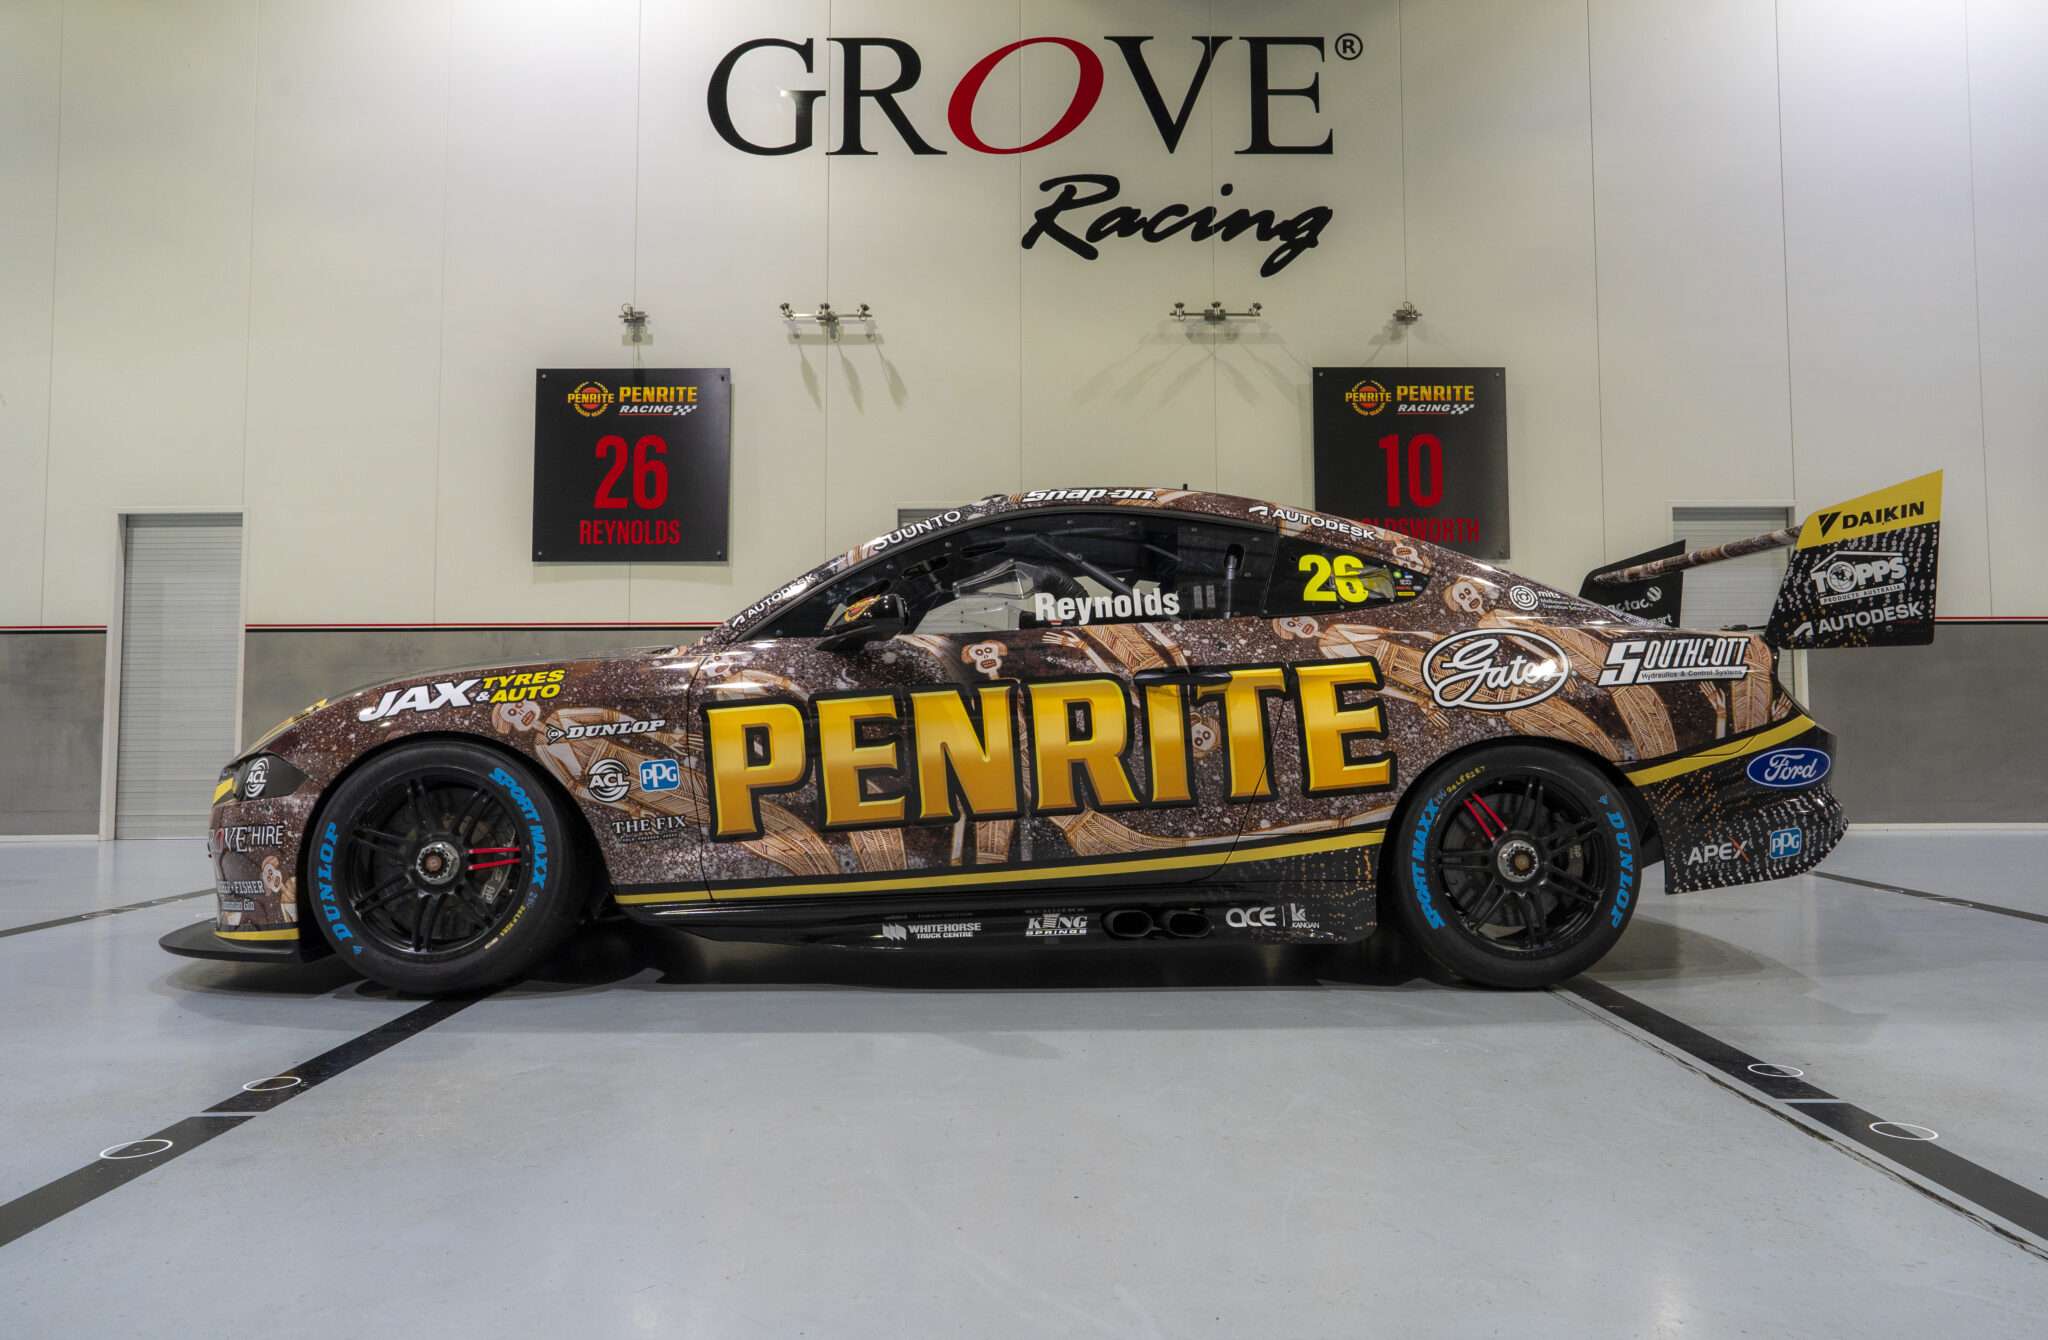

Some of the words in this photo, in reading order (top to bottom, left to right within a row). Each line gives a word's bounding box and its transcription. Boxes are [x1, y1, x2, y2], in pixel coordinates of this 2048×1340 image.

[707, 36, 1333, 156] GROVE
[1021, 173, 1333, 278] Racing
[567, 392, 615, 404] PENRITE
[619, 386, 698, 403] PENRITE
[1345, 391, 1392, 403] PENRITE
[1396, 385, 1475, 402] PENRITE
[619, 405, 673, 414] RACING
[1397, 404, 1451, 412] RACING
[594, 434, 669, 510] 26
[1378, 433, 1444, 508] 10
[1272, 508, 1377, 540] AUTODESK
[1842, 501, 1925, 529] DAIKIN
[579, 520, 681, 545] REYNOLDS
[873, 510, 962, 550] SUUNTO
[1298, 554, 1369, 603] 26
[1810, 557, 1907, 593] TOPPS
[1863, 585, 1900, 596] AUSTRALIA
[1034, 588, 1180, 625] Reynolds
[1818, 601, 1923, 634] AUTODESK
[1598, 638, 1749, 686] SOUTHCOTT
[482, 670, 566, 689] TYRES
[358, 679, 481, 722] JAX
[475, 691, 491, 703] &
[490, 684, 561, 704] AUTO
[566, 719, 666, 739] DUNLOP
[706, 662, 1392, 835] PENRITE
[246, 770, 267, 784] ACL
[589, 773, 630, 788] ACL
[641, 763, 678, 788] PPG
[1764, 753, 1819, 782] Ford
[251, 825, 284, 845] HIRE
[488, 767, 541, 822] SPORT
[528, 824, 548, 891] MAXX
[612, 819, 650, 834] THE
[656, 815, 687, 830] FIX
[1411, 797, 1441, 862] MAXX
[1688, 837, 1750, 866] APEX
[1772, 832, 1801, 855] PPG
[318, 822, 353, 940] DUNLOP
[1606, 811, 1633, 928] DUNLOP
[1411, 862, 1446, 929] SPORT
[908, 922, 982, 934] WHITEHORSE
[916, 932, 942, 940] TRUCK
[943, 931, 973, 939] CENTRE
